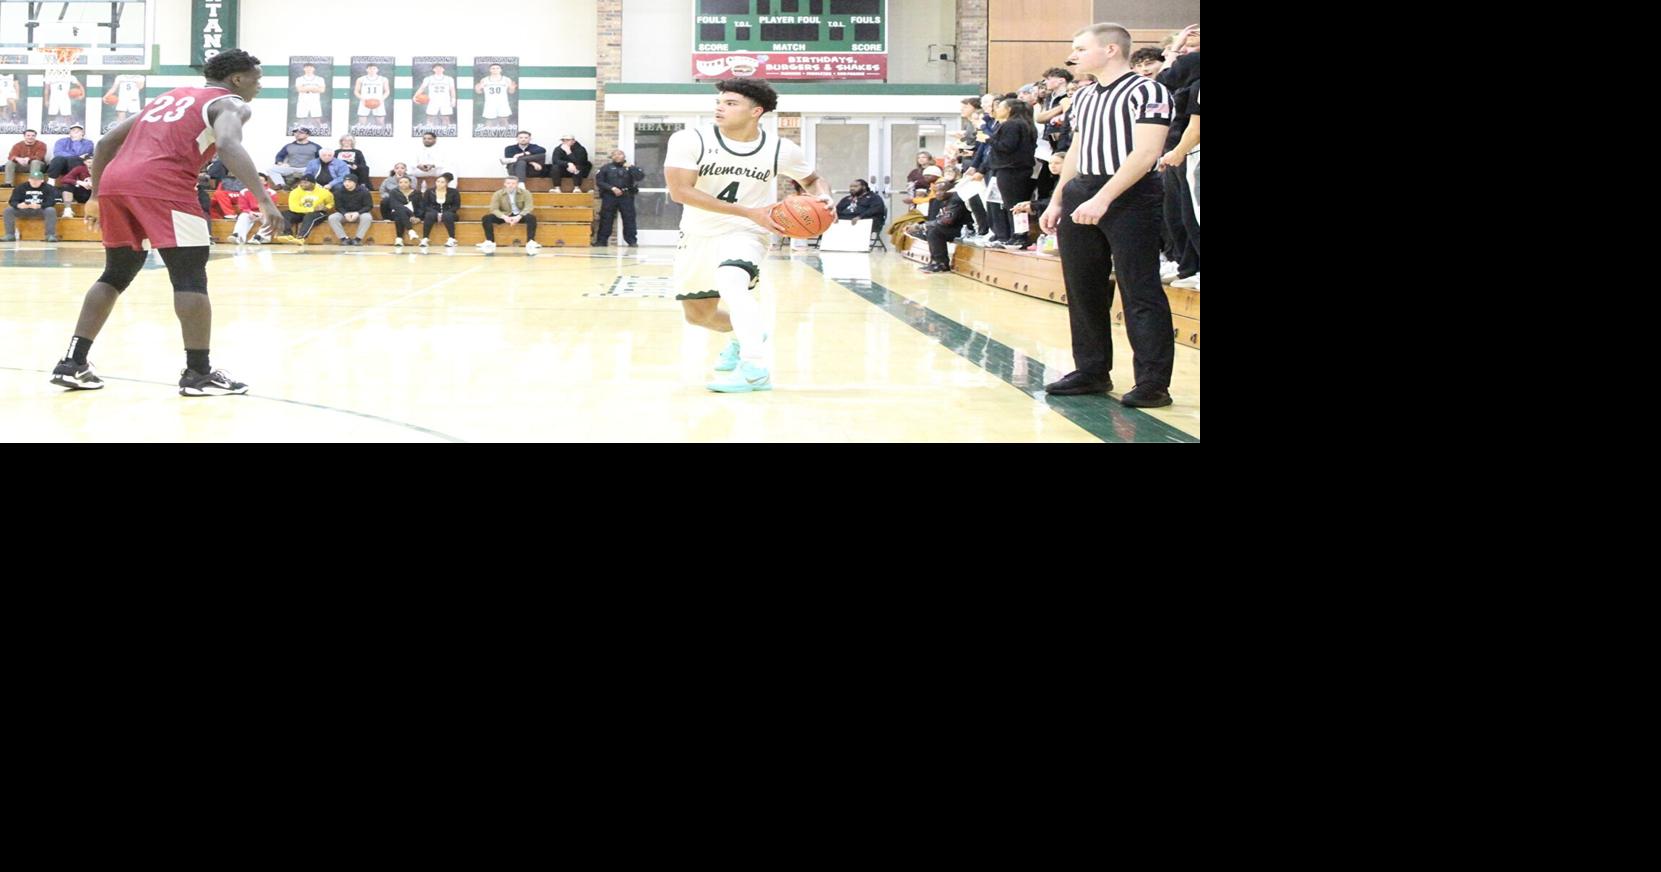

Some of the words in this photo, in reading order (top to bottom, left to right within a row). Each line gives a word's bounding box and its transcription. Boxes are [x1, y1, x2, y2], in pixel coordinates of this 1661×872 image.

[697, 16, 727, 24] FOULS
[759, 16, 794, 24] PLAYER
[798, 16, 821, 24] FOUL
[850, 16, 881, 24] FOULS
[203, 0, 223, 63] TANS
[698, 43, 728, 51] SCORE
[772, 43, 806, 51] MATCH
[851, 43, 882, 51] SCORE
[489, 86, 501, 94] 30
[140, 95, 196, 123] 23
[698, 162, 771, 183] Memorial
[716, 180, 741, 204] 4
